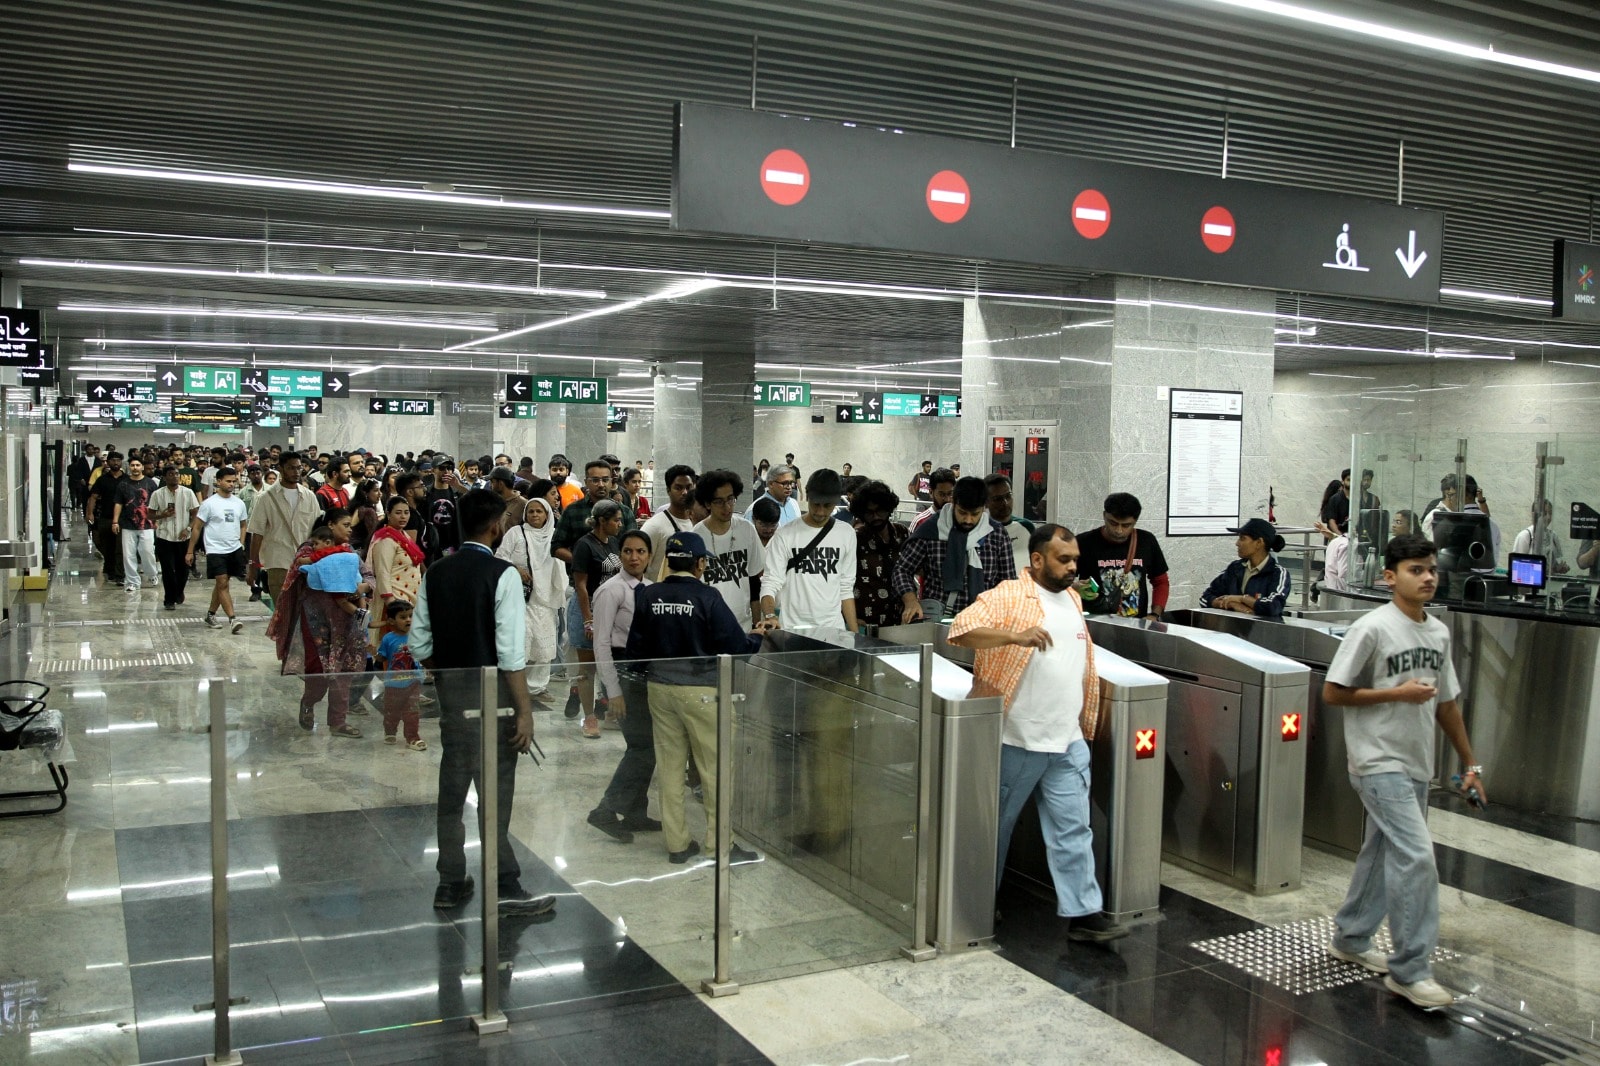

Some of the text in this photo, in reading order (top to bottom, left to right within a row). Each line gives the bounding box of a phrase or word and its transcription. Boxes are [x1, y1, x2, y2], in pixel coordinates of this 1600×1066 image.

[1574, 294, 1595, 304] MMRC
[217, 377, 228, 389] A
[537, 379, 553, 390] बाहेर
[563, 387, 573, 398] A
[582, 388, 591, 398] B
[772, 391, 781, 401] A
[789, 391, 797, 401] B
[703, 562, 749, 589] PARK
[794, 559, 839, 582] PARK
[651, 597, 695, 617] सोनावणे
